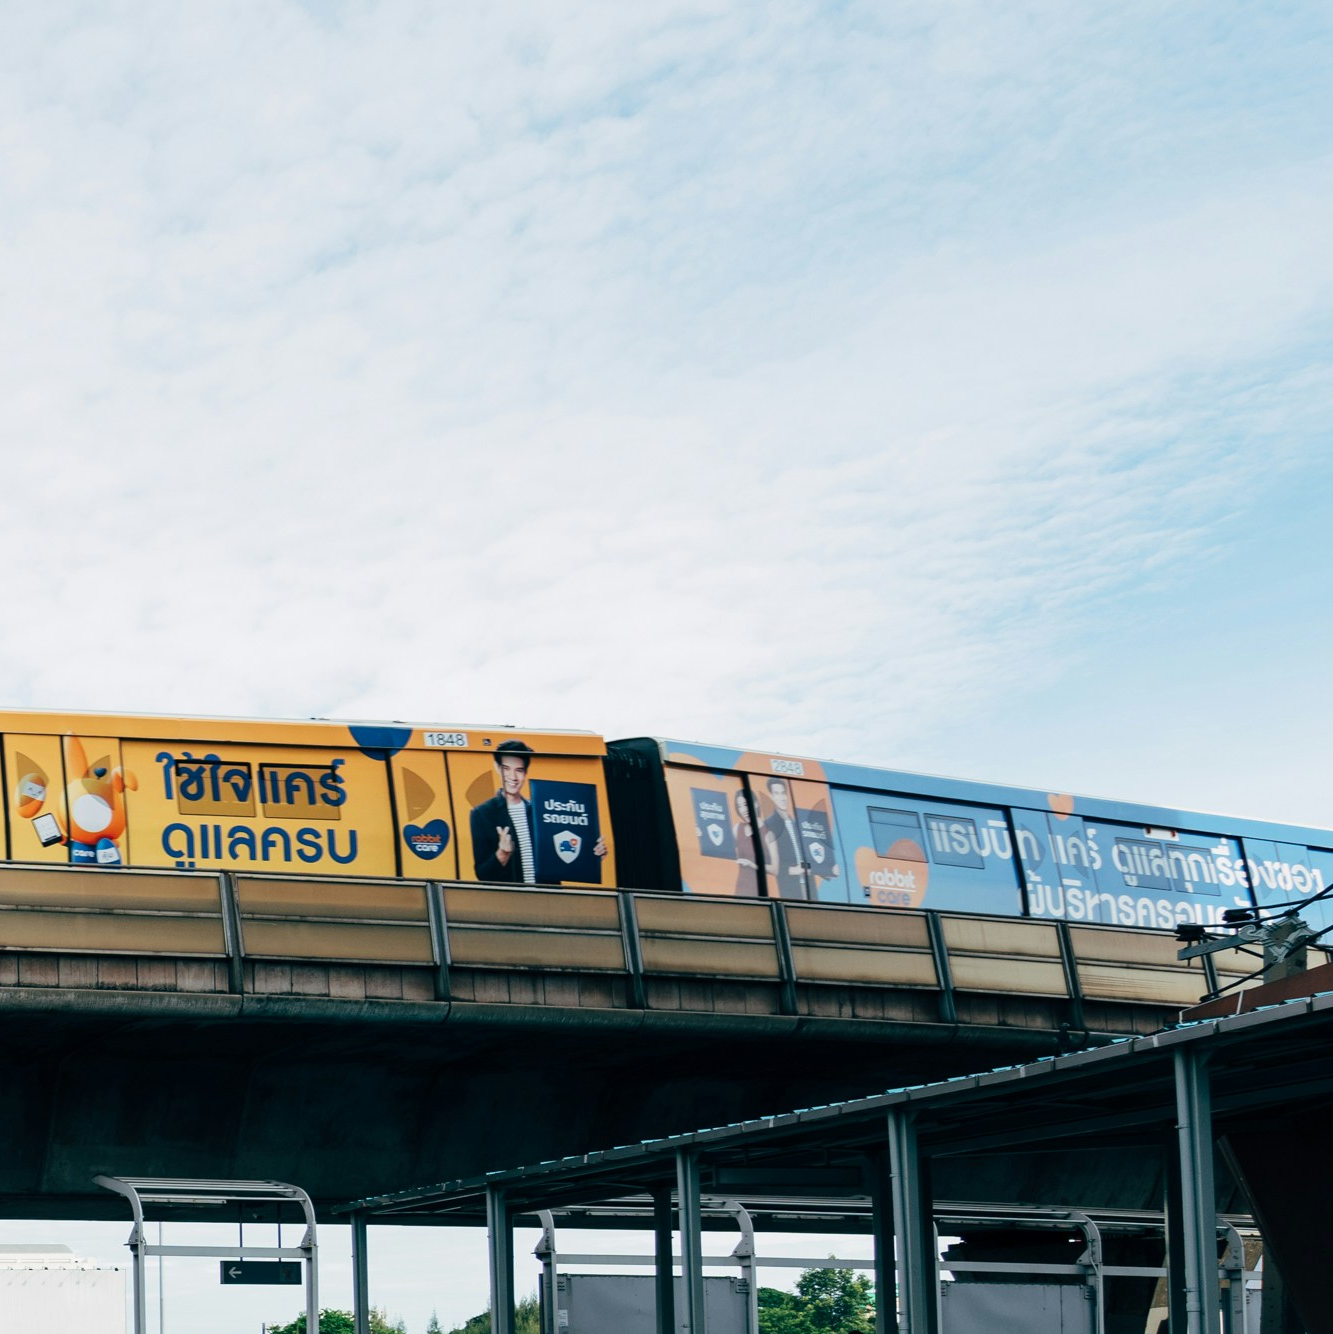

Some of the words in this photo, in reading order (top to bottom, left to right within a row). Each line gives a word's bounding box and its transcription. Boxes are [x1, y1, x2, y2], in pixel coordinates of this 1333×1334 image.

[427, 732, 466, 747] 1848
[773, 759, 802, 775] 2848
[155, 751, 347, 807] ใช้ใจแคร์
[544, 799, 586, 812] ประกัน
[543, 813, 589, 826] รถยนต์
[411, 834, 442, 843] rabbit
[73, 849, 96, 858] care
[162, 822, 358, 872] ดูแลครบ
[415, 844, 440, 853] care
[869, 868, 916, 889] rabbit
[877, 890, 911, 906] care
